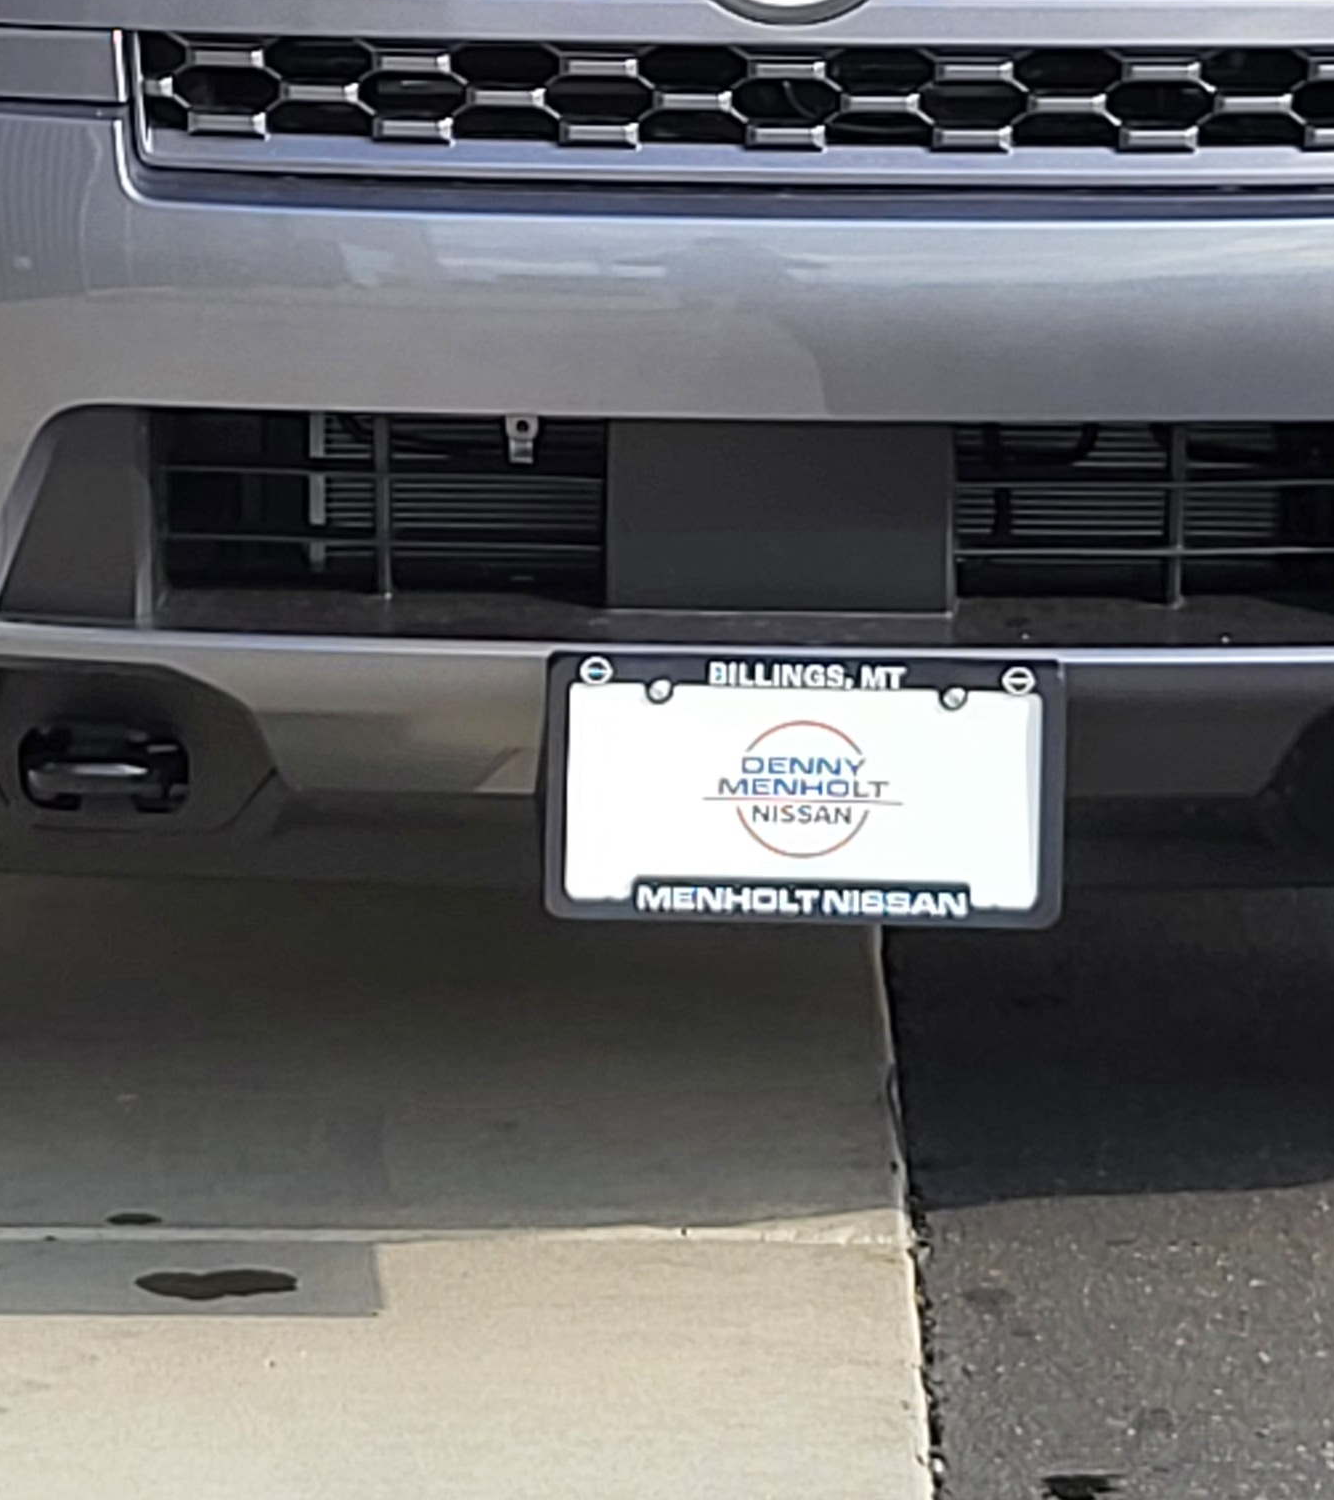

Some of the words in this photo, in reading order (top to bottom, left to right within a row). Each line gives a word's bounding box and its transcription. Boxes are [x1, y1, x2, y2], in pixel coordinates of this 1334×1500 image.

[707, 661, 855, 690] BILLINGS,
[860, 665, 907, 689] MT
[741, 757, 866, 776] DENNY
[717, 778, 890, 798] MENHOLT
[752, 804, 852, 825] NISSAN
[636, 884, 820, 913] MENHOLT
[822, 888, 968, 916] NISSAN
